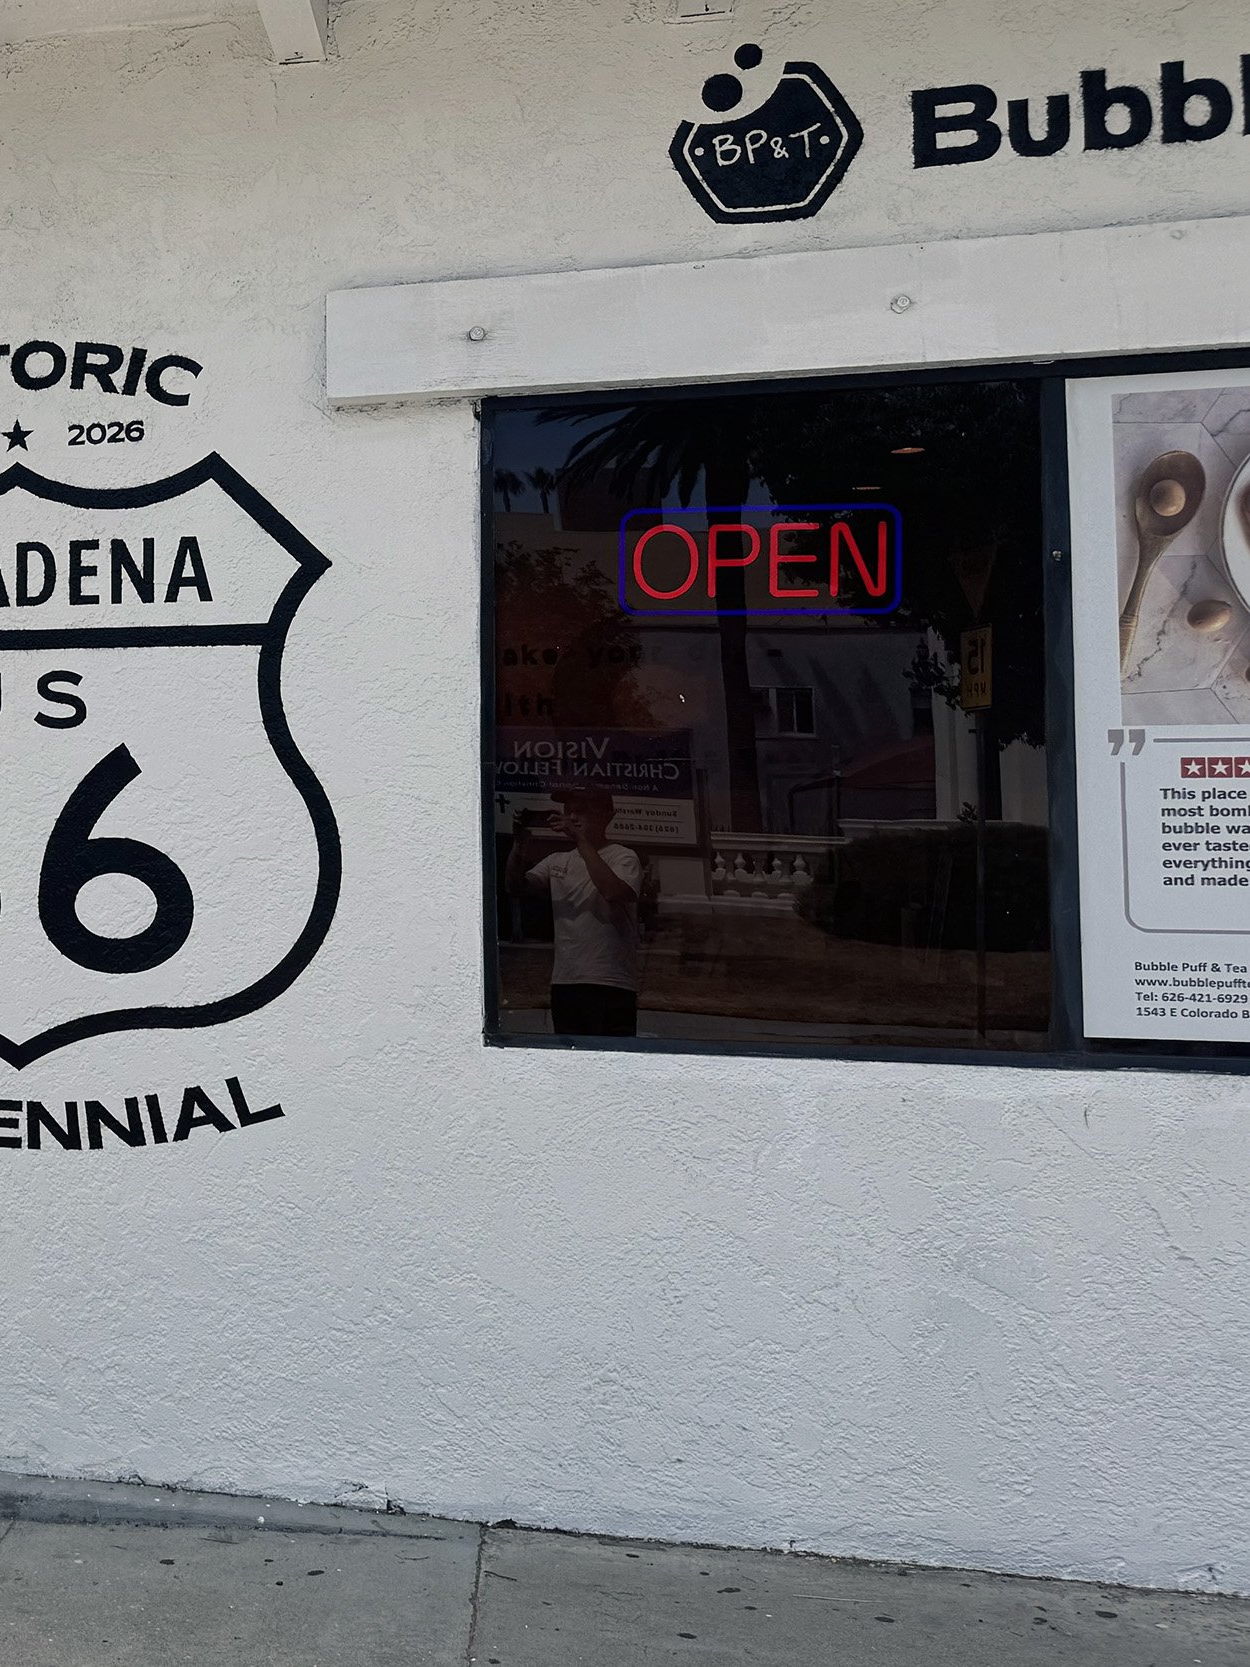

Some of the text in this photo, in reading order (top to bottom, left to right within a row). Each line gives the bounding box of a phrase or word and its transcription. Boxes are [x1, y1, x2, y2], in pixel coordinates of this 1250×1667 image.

[712, 123, 822, 167] BP&T
[67, 420, 145, 446] 2026
[631, 521, 888, 599] OPEN
[1160, 787, 1247, 802] This place
[1161, 804, 1250, 817] most bom
[1161, 822, 1250, 834] bubble wa
[1161, 840, 1250, 852] ever taste
[1163, 873, 1249, 887] and made
[1134, 961, 1248, 973] Bubble Puff & Tea
[1135, 991, 1248, 1004] Tel: 626-421-6929
[1136, 1007, 1166, 1017] 1543
[1170, 1007, 1178, 1017] E
[1180, 1008, 1238, 1019] Colorado
